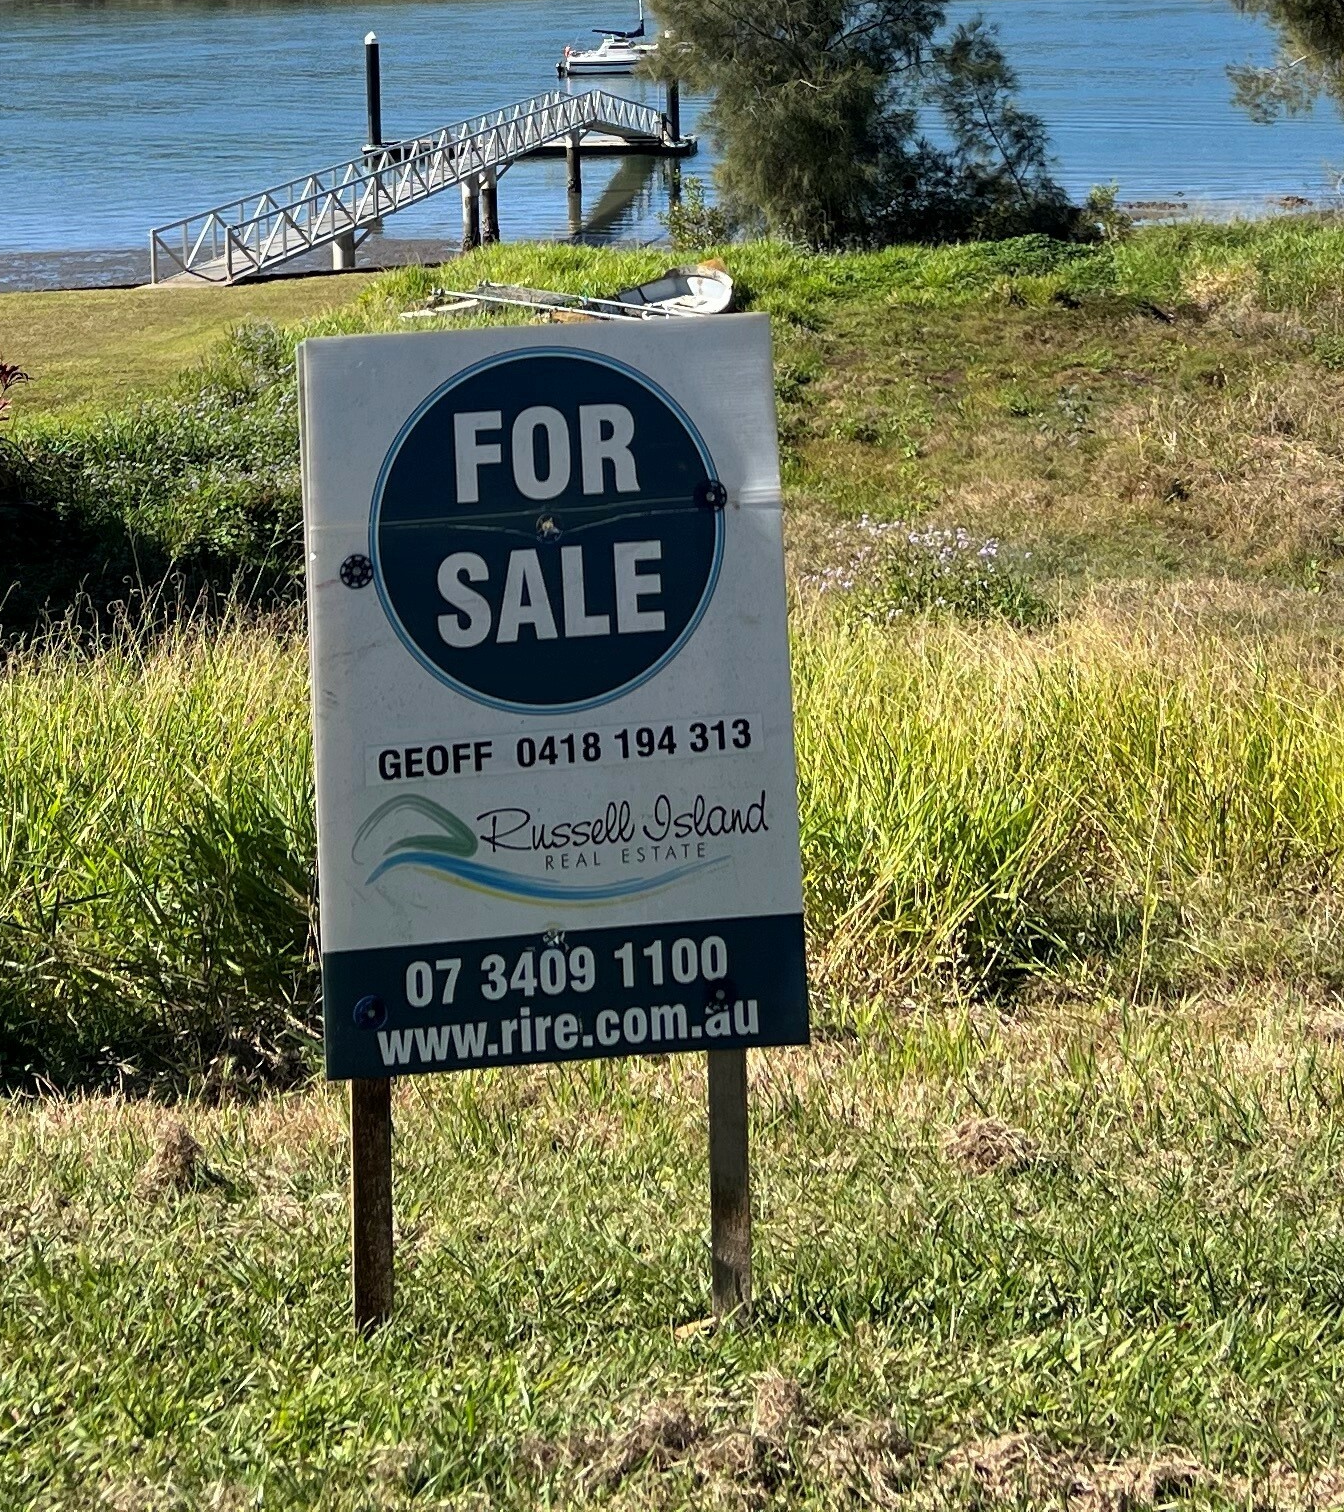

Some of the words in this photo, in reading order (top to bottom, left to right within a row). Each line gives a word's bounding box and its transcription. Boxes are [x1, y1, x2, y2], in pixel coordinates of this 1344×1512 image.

[453, 403, 641, 504] FOR
[436, 539, 666, 648] SALE
[378, 740, 493, 780] GEOFF
[516, 732, 601, 768] 0418
[614, 725, 677, 758] 194
[689, 718, 752, 752] 313
[476, 800, 636, 853] Russell
[642, 789, 770, 841] Island
[545, 851, 601, 871] REAL
[621, 842, 707, 864] ESTATE
[405, 958, 462, 1007] 07
[480, 946, 596, 1001] 3409
[614, 935, 728, 989] 1100
[377, 999, 759, 1066] www.rire.com.au
